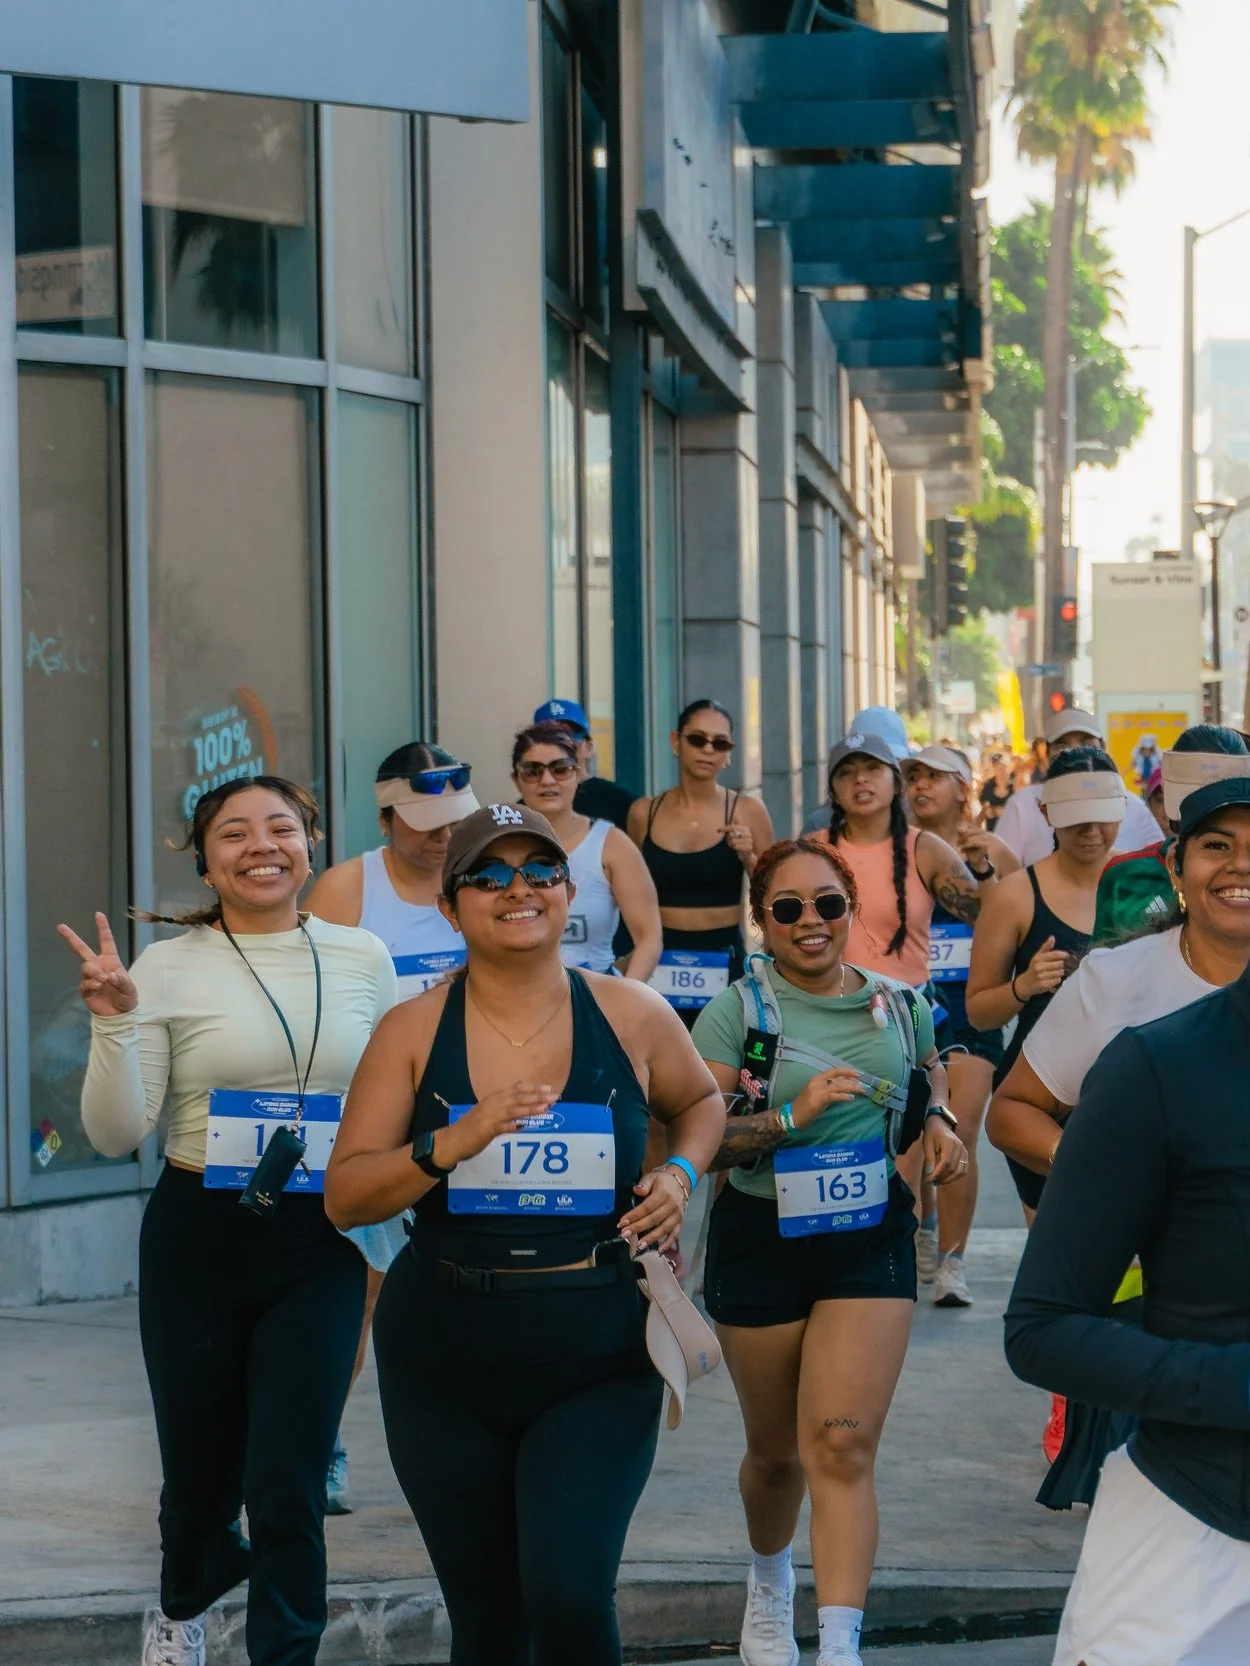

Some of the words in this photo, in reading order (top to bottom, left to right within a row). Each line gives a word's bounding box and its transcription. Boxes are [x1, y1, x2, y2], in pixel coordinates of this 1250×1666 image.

[193, 719, 252, 776] 100%
[488, 803, 523, 826] LA
[671, 970, 705, 988] 186
[500, 1140, 570, 1175] 178
[816, 1171, 867, 1203] 163
